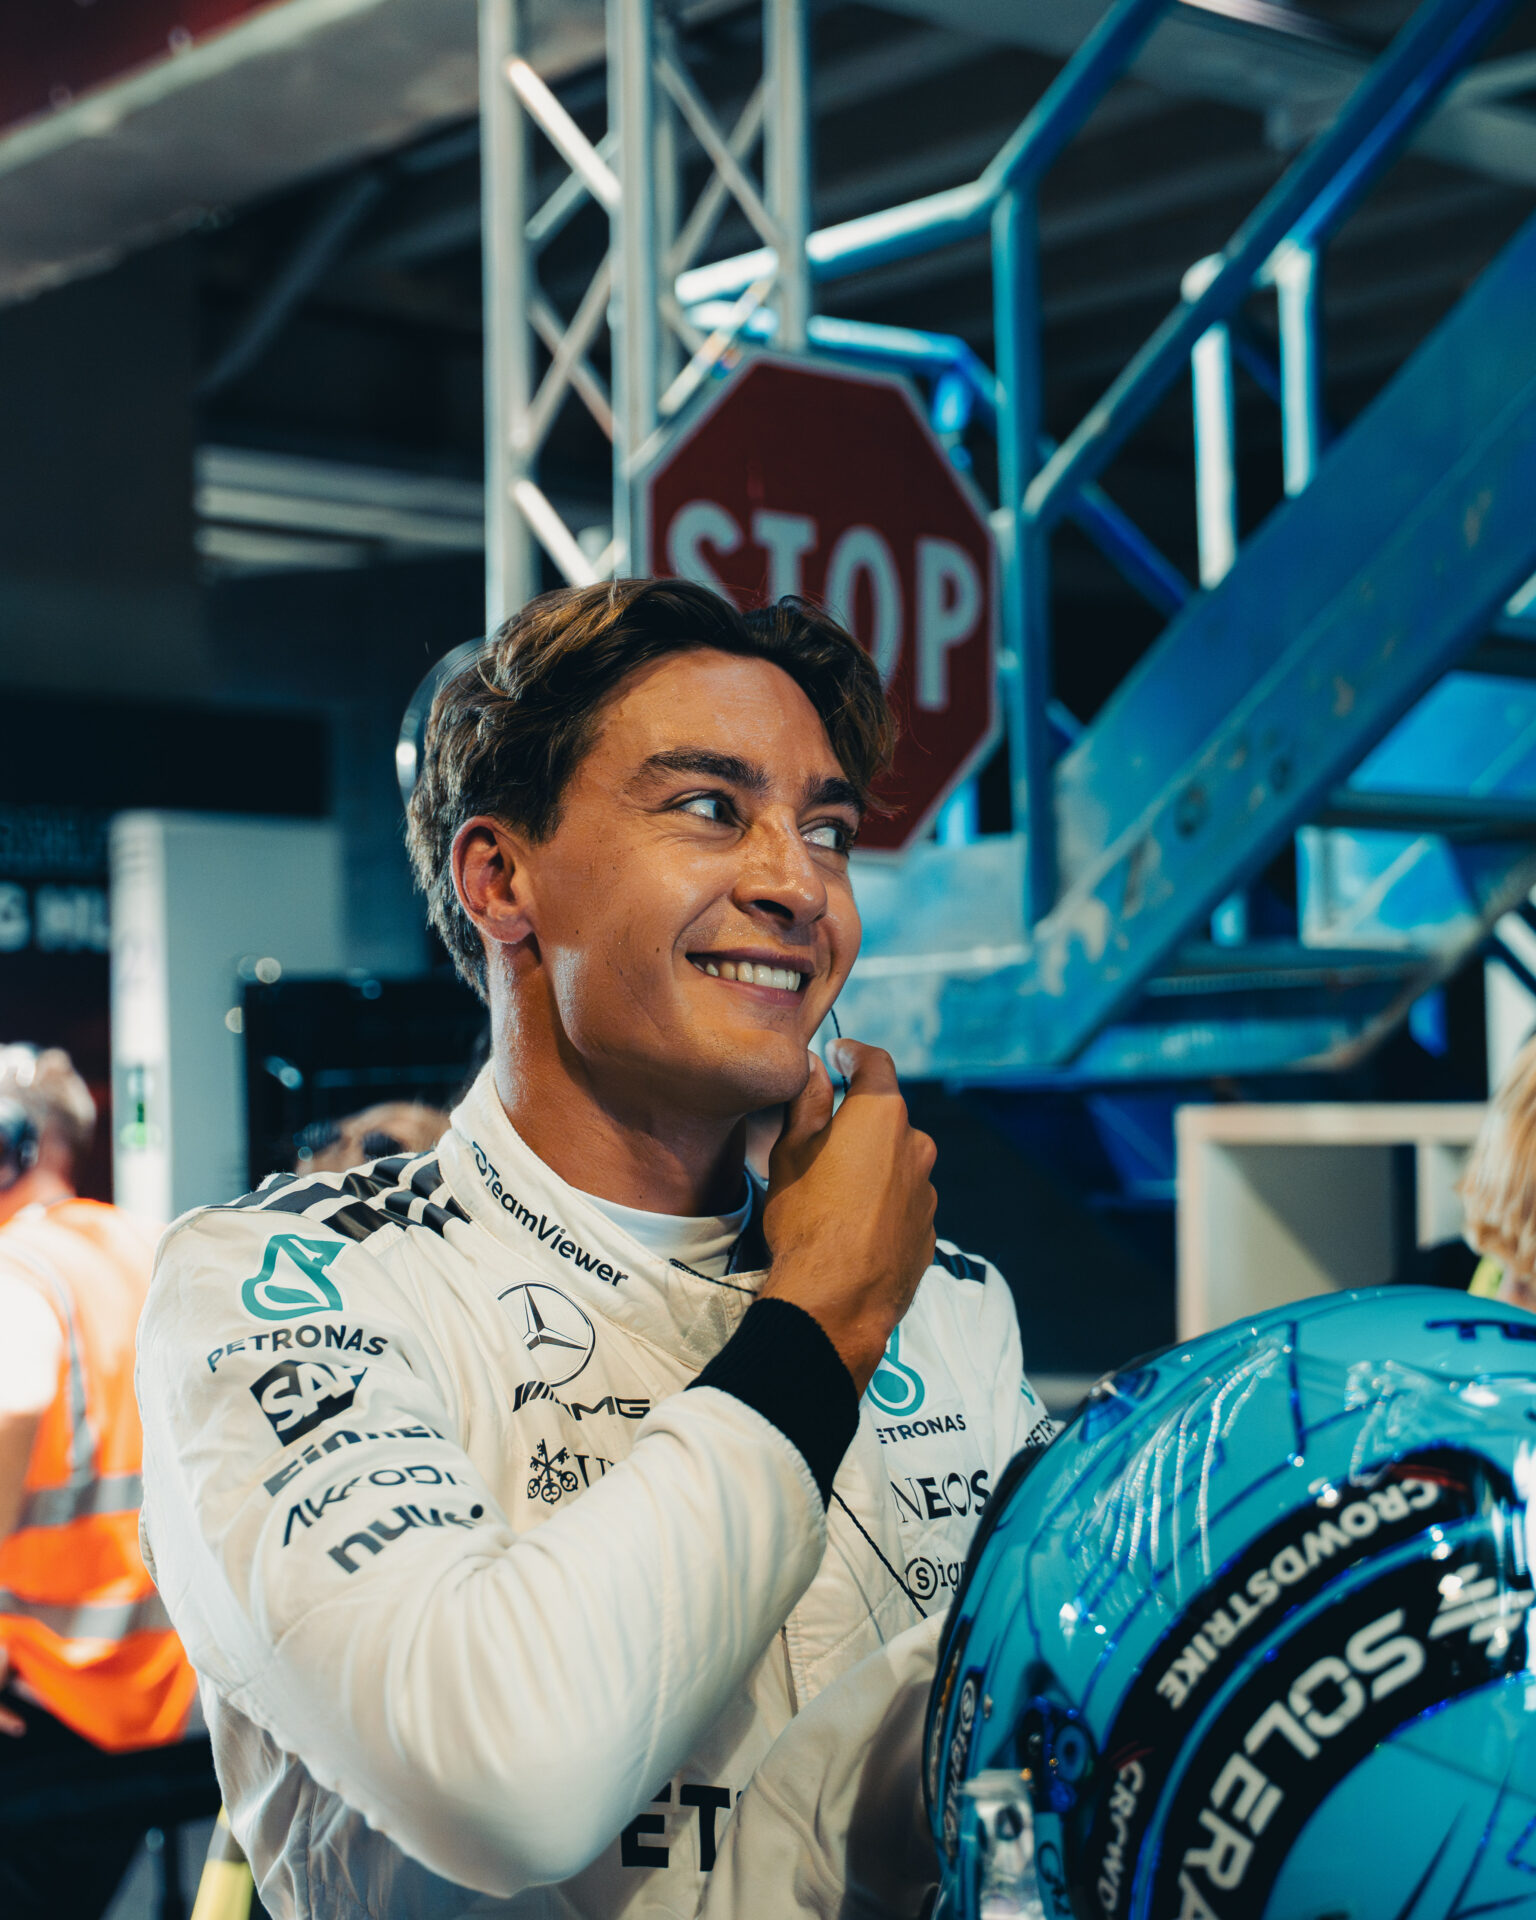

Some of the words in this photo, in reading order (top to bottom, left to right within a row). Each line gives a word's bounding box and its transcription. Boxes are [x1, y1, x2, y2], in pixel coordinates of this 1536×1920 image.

[666, 499, 981, 711] STOP
[487, 1163, 630, 1288] TeamViewer
[206, 1324, 389, 1373] PETRONAS
[876, 1413, 967, 1445] ETRONAS
[889, 1469, 992, 1523] NEOS
[1155, 1476, 1440, 1710] CROWDSTRIKE
